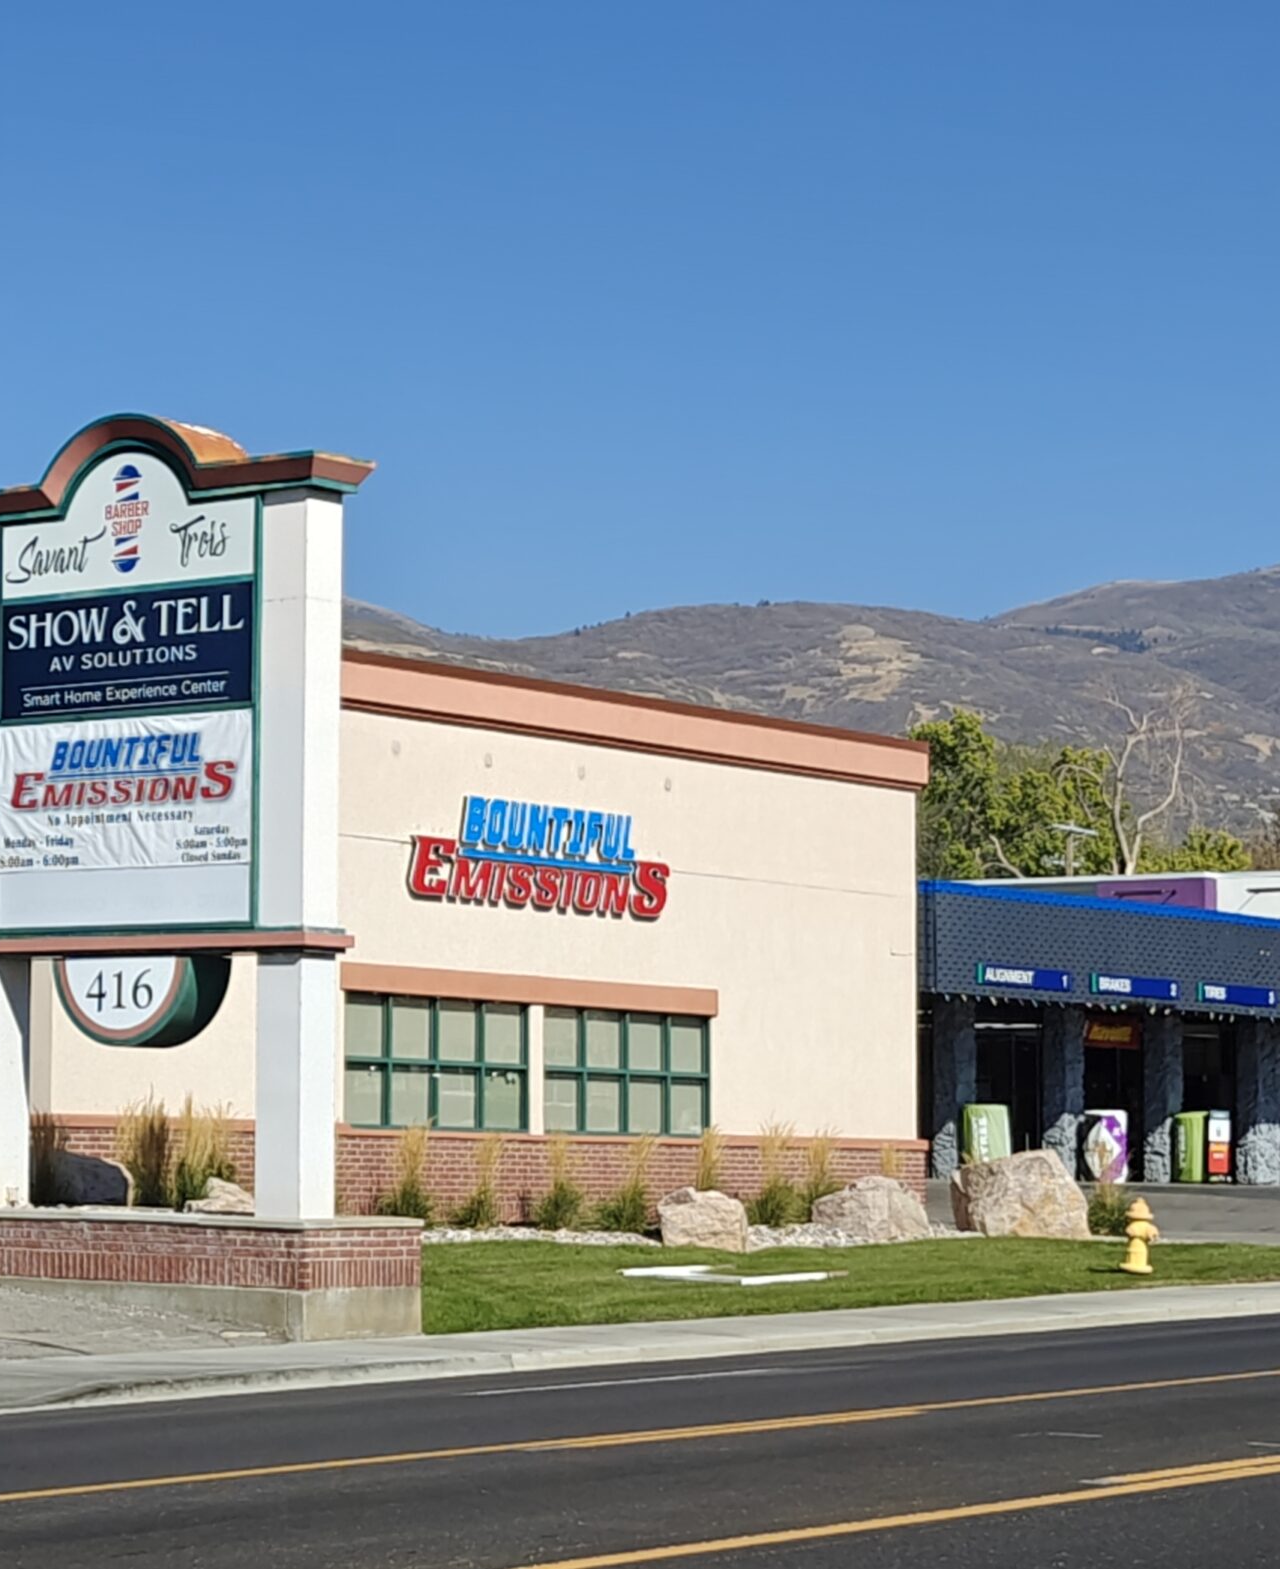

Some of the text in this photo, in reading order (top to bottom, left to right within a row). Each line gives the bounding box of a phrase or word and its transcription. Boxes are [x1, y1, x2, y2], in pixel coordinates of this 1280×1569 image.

[105, 500, 149, 520] BARBER
[111, 519, 142, 537] SHOP
[6, 515, 231, 583] Savant Trois
[8, 595, 244, 650] SHOW & TELL
[49, 644, 197, 672] AV SOLUTIONS
[23, 678, 226, 708] Smart Home Experience Center
[51, 732, 201, 772] BOUNTIFUL
[10, 760, 236, 810] EMISSIONS
[48, 809, 193, 828] No Appointment Necessary
[460, 795, 636, 861] BOUNTIFUL
[4, 835, 36, 850] Monday
[46, 834, 74, 848] Friday
[406, 834, 670, 922] EMISSIONS
[85, 968, 154, 1012] 416
